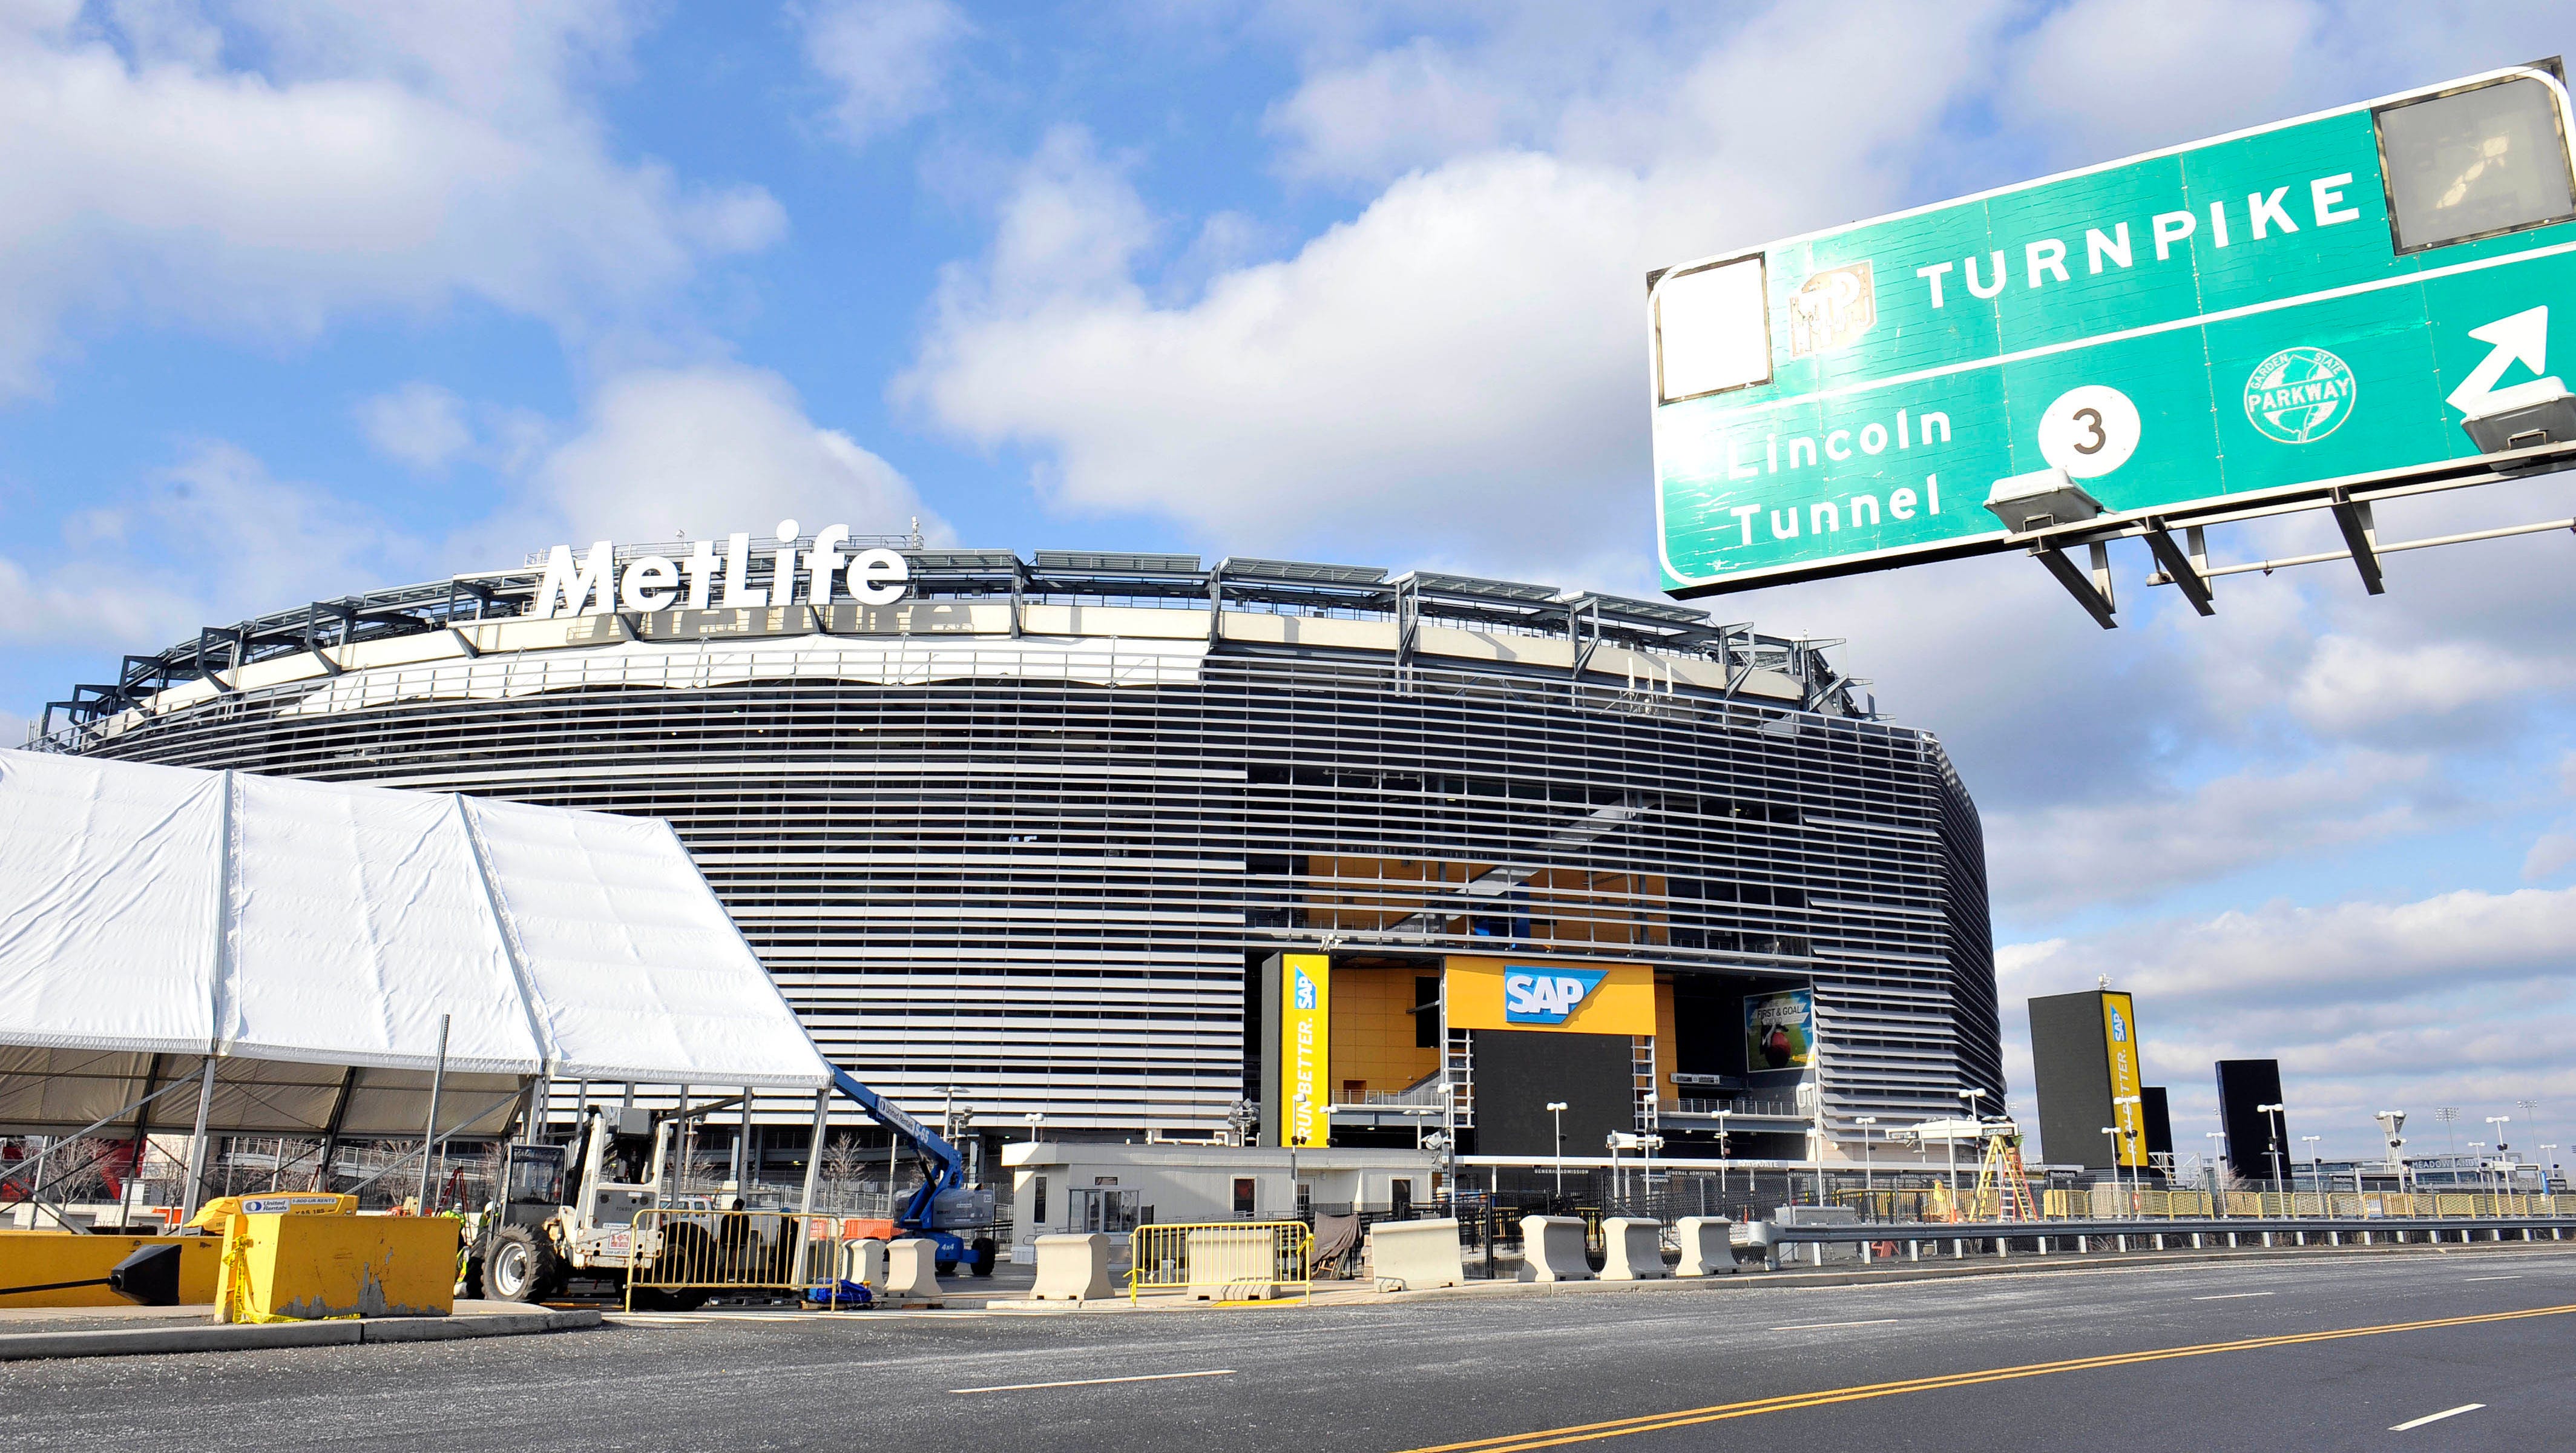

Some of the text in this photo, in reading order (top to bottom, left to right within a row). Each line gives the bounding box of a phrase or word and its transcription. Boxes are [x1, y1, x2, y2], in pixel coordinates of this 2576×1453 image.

[1916, 172, 2360, 309] TURNPIKE
[2250, 352, 2344, 389] GARDEN STATE
[2248, 378, 2350, 413] PARKWAY
[1727, 408, 1952, 480] Lincoln
[2072, 407, 2106, 455] 3
[1730, 473, 1940, 546] Tunnel
[533, 519, 910, 618] MetLife
[1298, 976, 1312, 1009] SAP
[1506, 975, 1584, 1014] SAP
[1757, 1006, 1802, 1018] FIRST & GOAL
[2114, 1013, 2125, 1041] SAP
[1297, 1018, 1312, 1141] RUN BETTER.
[886, 1104, 900, 1121] United
